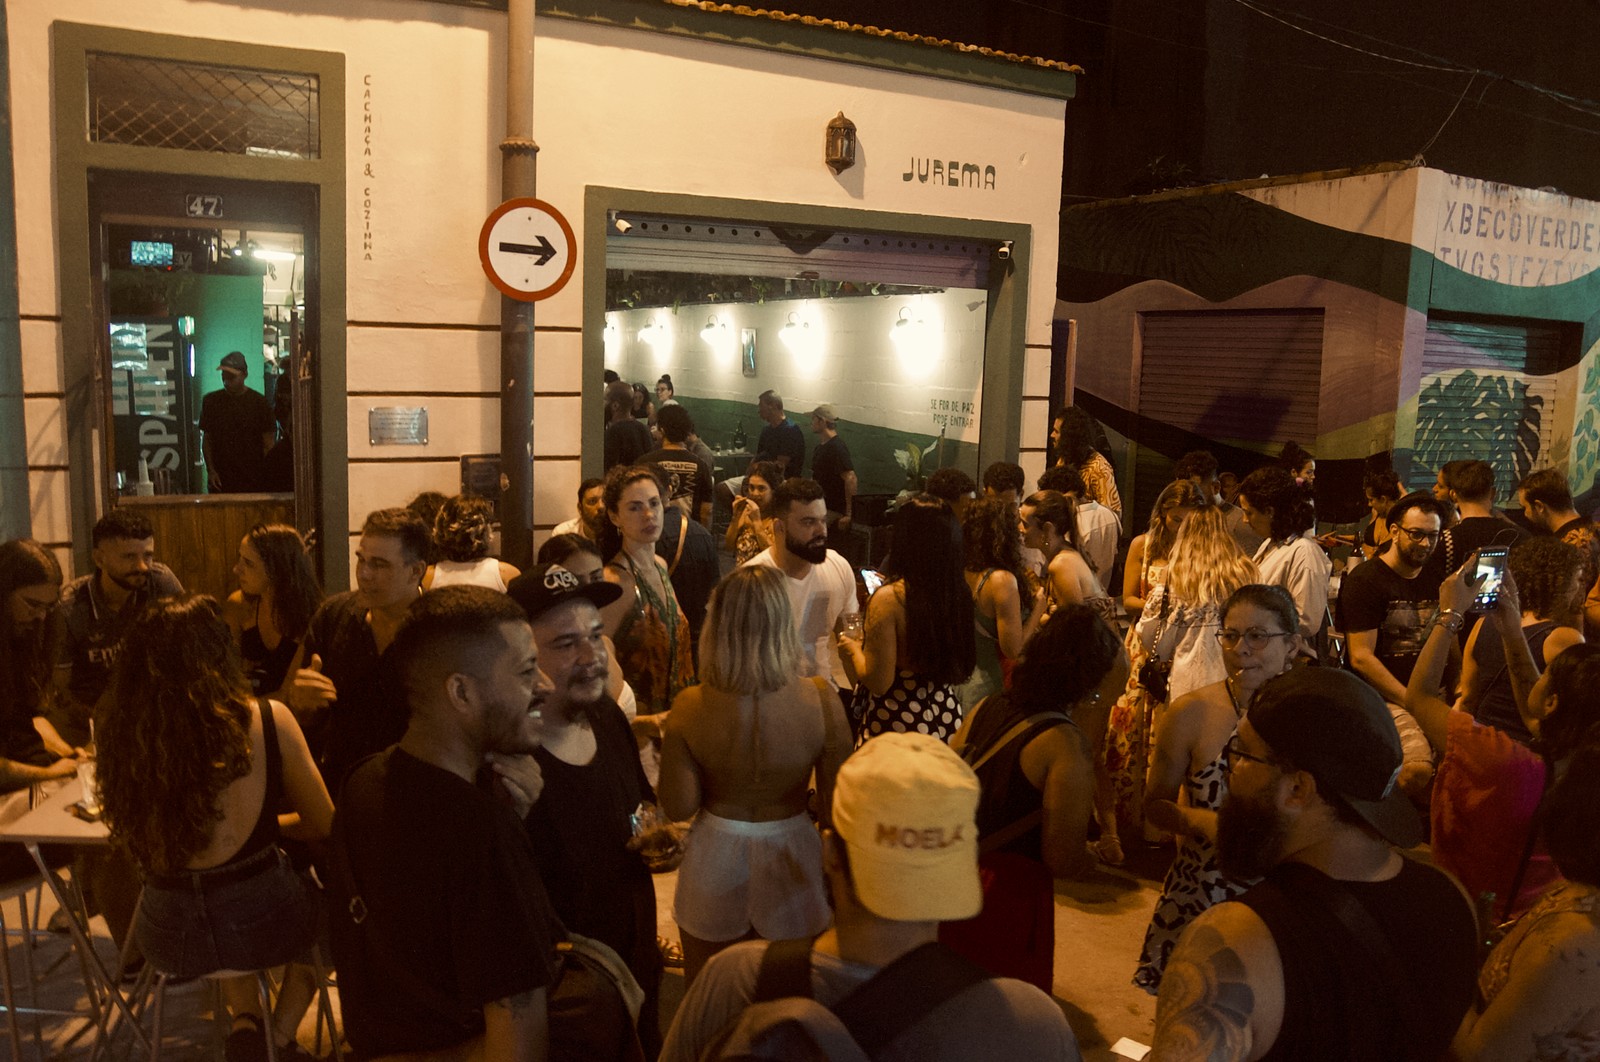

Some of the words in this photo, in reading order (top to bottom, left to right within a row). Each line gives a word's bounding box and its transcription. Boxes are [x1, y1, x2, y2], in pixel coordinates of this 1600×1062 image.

[363, 75, 372, 156] CACHAÇA
[363, 163, 375, 179] &
[902, 156, 996, 191] JUREMA
[189, 196, 219, 216] 47
[363, 187, 372, 261] COZINHA
[930, 399, 937, 410] SE
[939, 399, 949, 411] FOR
[951, 400, 959, 413] DE
[962, 402, 975, 415] PAZ
[933, 413, 948, 426] PODE
[950, 415, 974, 428] ENTRAR
